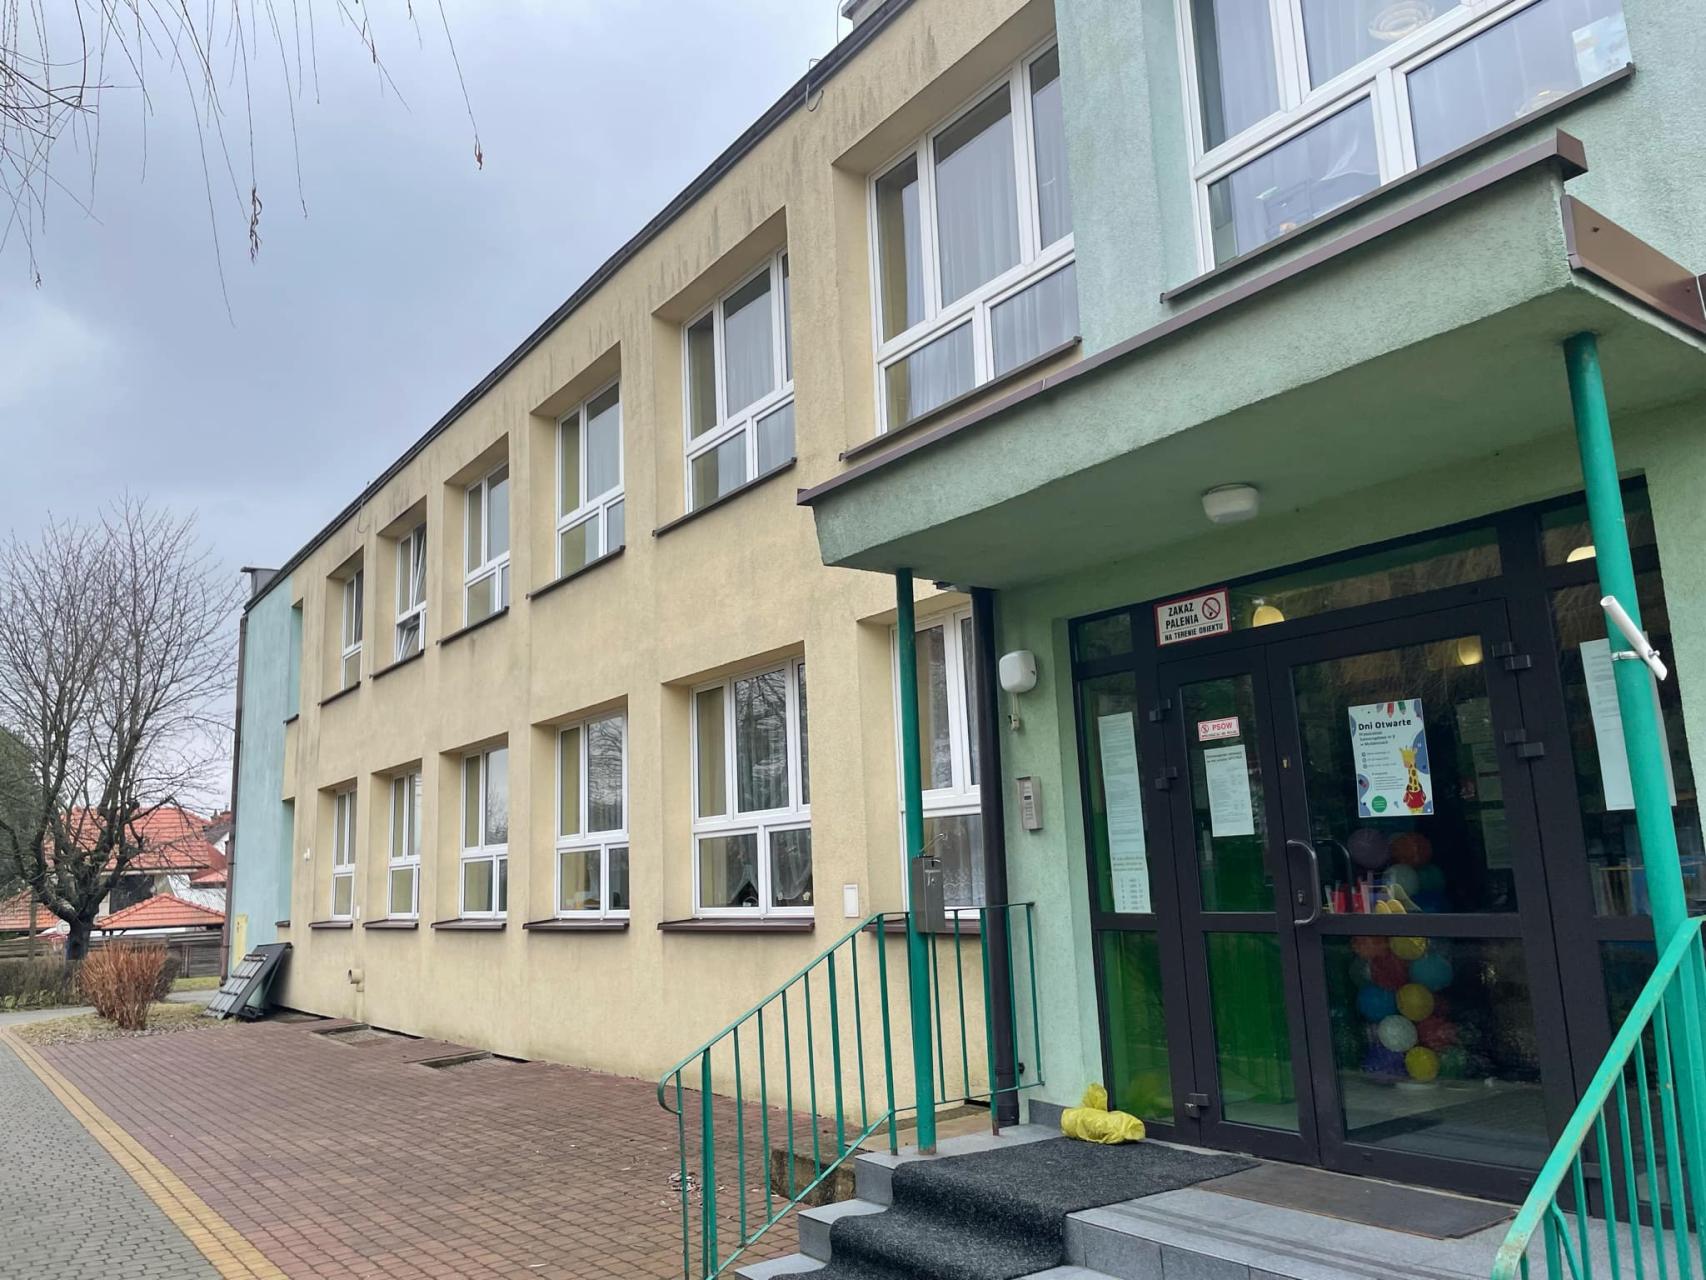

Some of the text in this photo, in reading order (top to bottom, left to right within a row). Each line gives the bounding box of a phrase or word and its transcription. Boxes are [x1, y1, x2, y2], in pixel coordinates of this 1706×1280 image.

[1168, 602, 1194, 617] ZAKAZ
[1166, 614, 1198, 630] PALENIA
[1164, 623, 1223, 641] NA TERENIE OBIEKTU
[1358, 719, 1412, 731] Dni Otwarte
